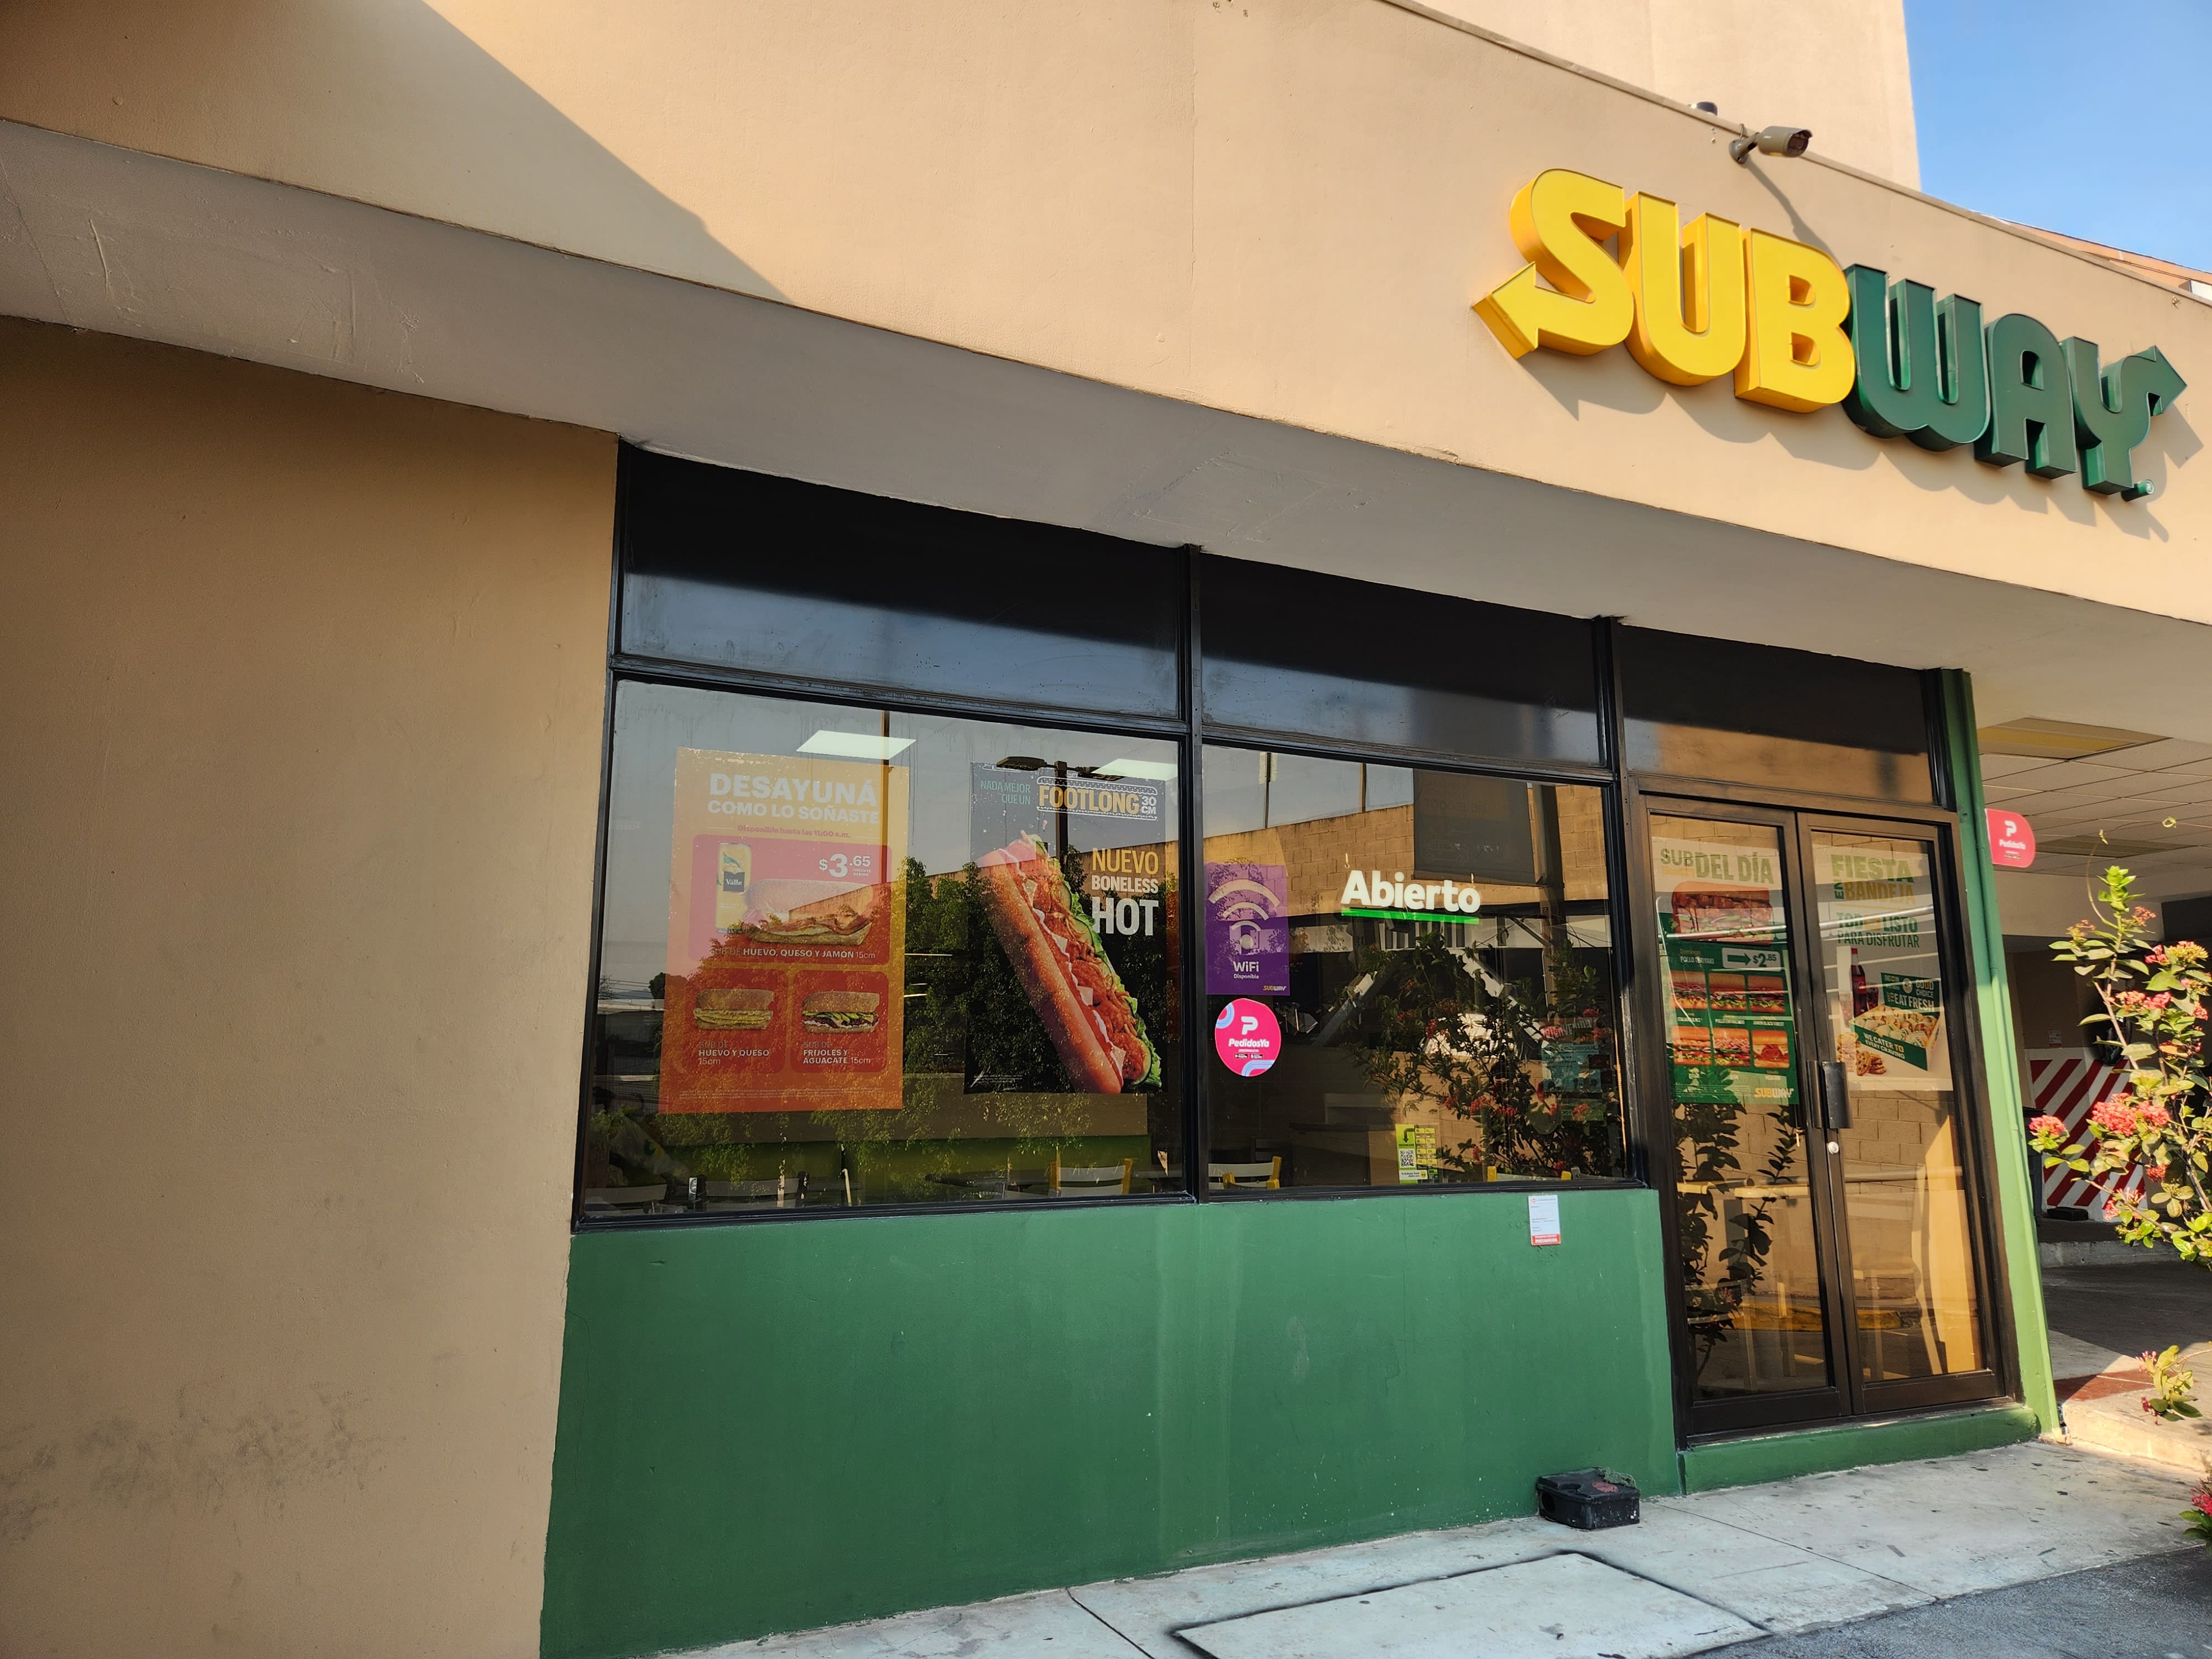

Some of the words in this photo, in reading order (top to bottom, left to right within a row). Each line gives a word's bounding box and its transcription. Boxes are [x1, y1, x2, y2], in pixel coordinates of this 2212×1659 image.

[1473, 168, 2188, 495] SUBWAY
[709, 773, 878, 806] DESAYUNÁ
[980, 780, 1003, 792] NADA
[1004, 782, 1031, 793] MEJOR
[1000, 794, 1018, 804] QUE
[1019, 796, 1031, 805] UN
[1039, 785, 1140, 815] FOOTLONG
[1141, 795, 1157, 807] 30
[707, 800, 767, 817] COMO
[771, 804, 795, 818] LO
[798, 805, 880, 824] SOÑASTE
[1141, 806, 1157, 815] CM
[819, 853, 871, 878] $3.65
[1092, 848, 1159, 875] NUEVO
[1660, 848, 1694, 867] SUB
[1695, 852, 1734, 880] DEL
[1737, 851, 1775, 884] DÍA
[1831, 854, 1914, 883] FIESTA
[1092, 875, 1159, 894] BONELESS
[1340, 870, 1481, 913] Abierto
[1844, 880, 1916, 905] BANDEJA
[1092, 896, 1159, 936] HOT
[1882, 916, 1918, 933] LISTO
[1837, 930, 1864, 946] PARA
[1866, 932, 1920, 948] DISFRUTAR
[743, 948, 778, 957] HUEVO,
[780, 949, 812, 957] QUESO
[1233, 961, 1259, 972] WiFi
[1894, 993, 1908, 1006] EAT
[1908, 995, 1935, 1012] FRESH
[1228, 1039, 1270, 1048] PedidosYa
[1865, 1040, 1880, 1050] EVERY
[1873, 1036, 1894, 1050] CATER
[1893, 1044, 1905, 1053] TO
[1754, 1088, 1794, 1098] SUBWAY
